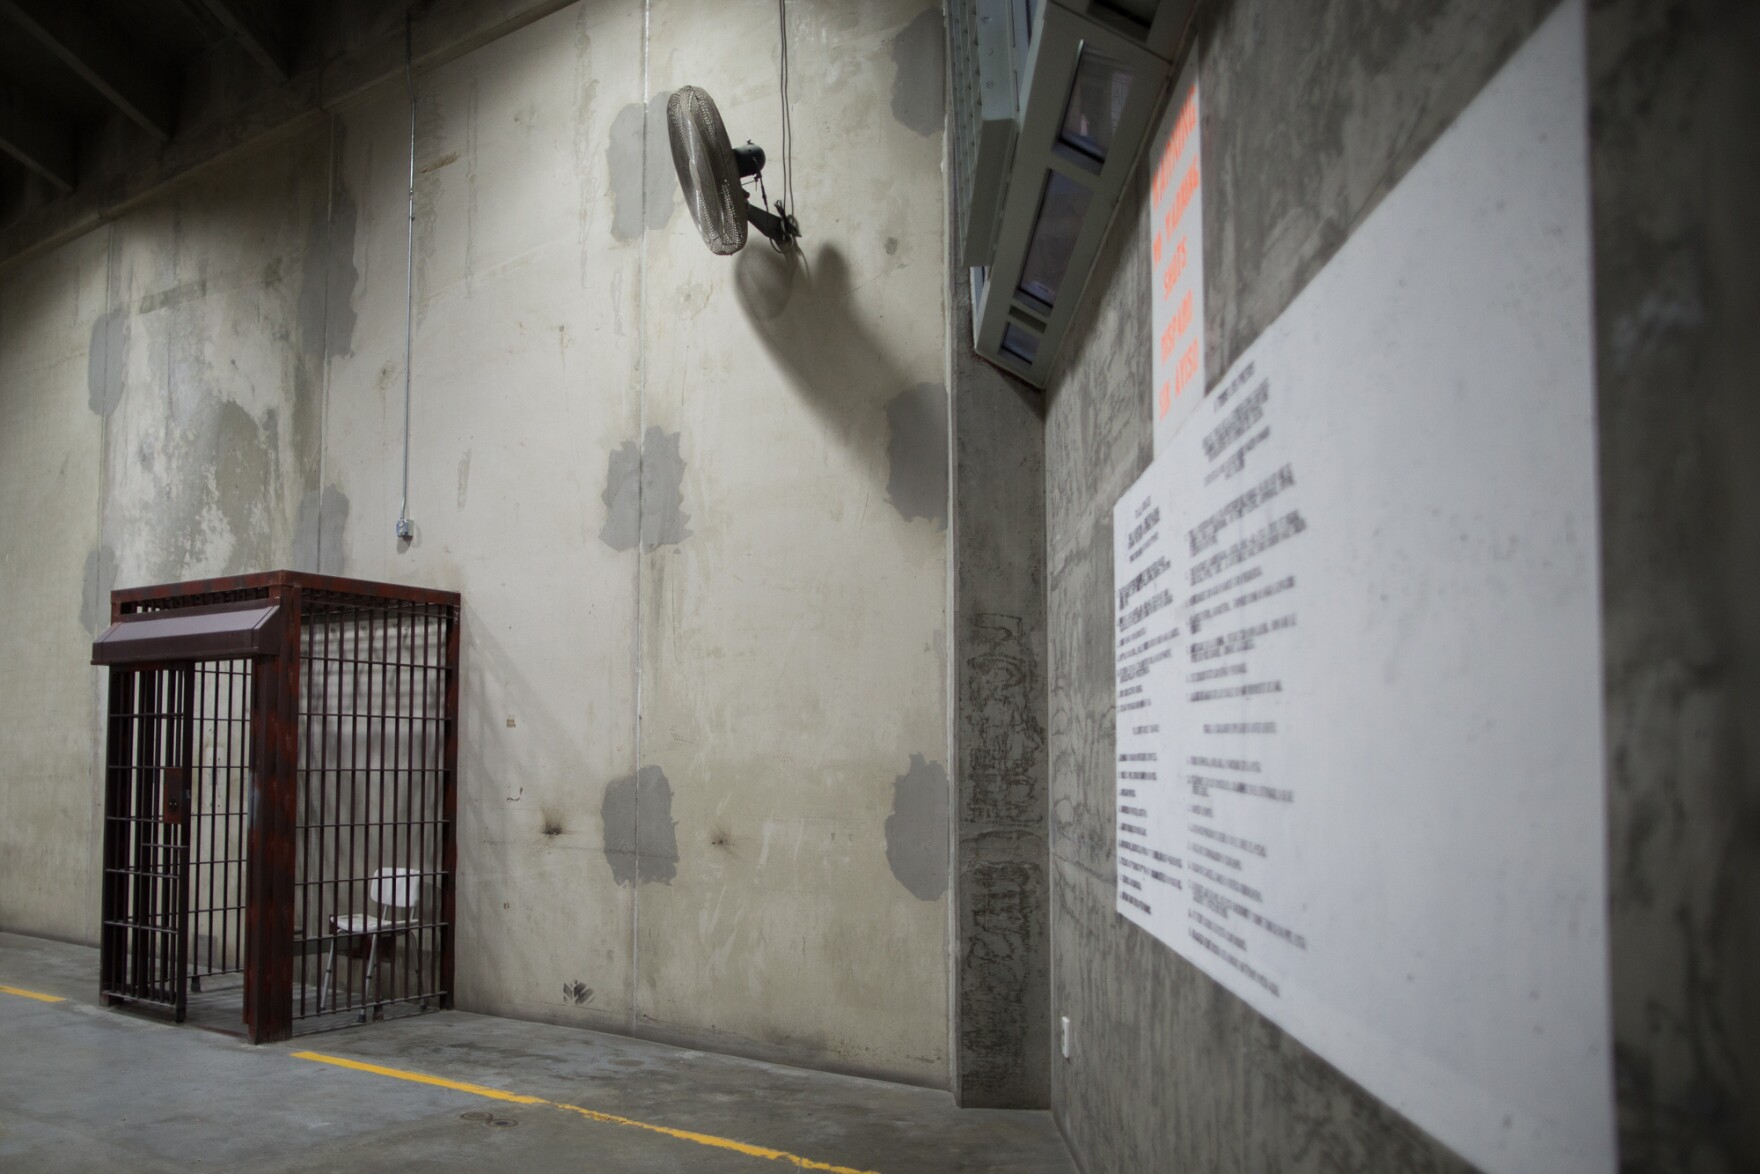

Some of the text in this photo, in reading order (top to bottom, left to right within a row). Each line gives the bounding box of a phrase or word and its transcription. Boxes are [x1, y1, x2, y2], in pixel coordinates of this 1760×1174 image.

[1152, 84, 1197, 210] WARNING
[1165, 154, 1200, 241] WARNING
[1163, 235, 1188, 300] SHOTS
